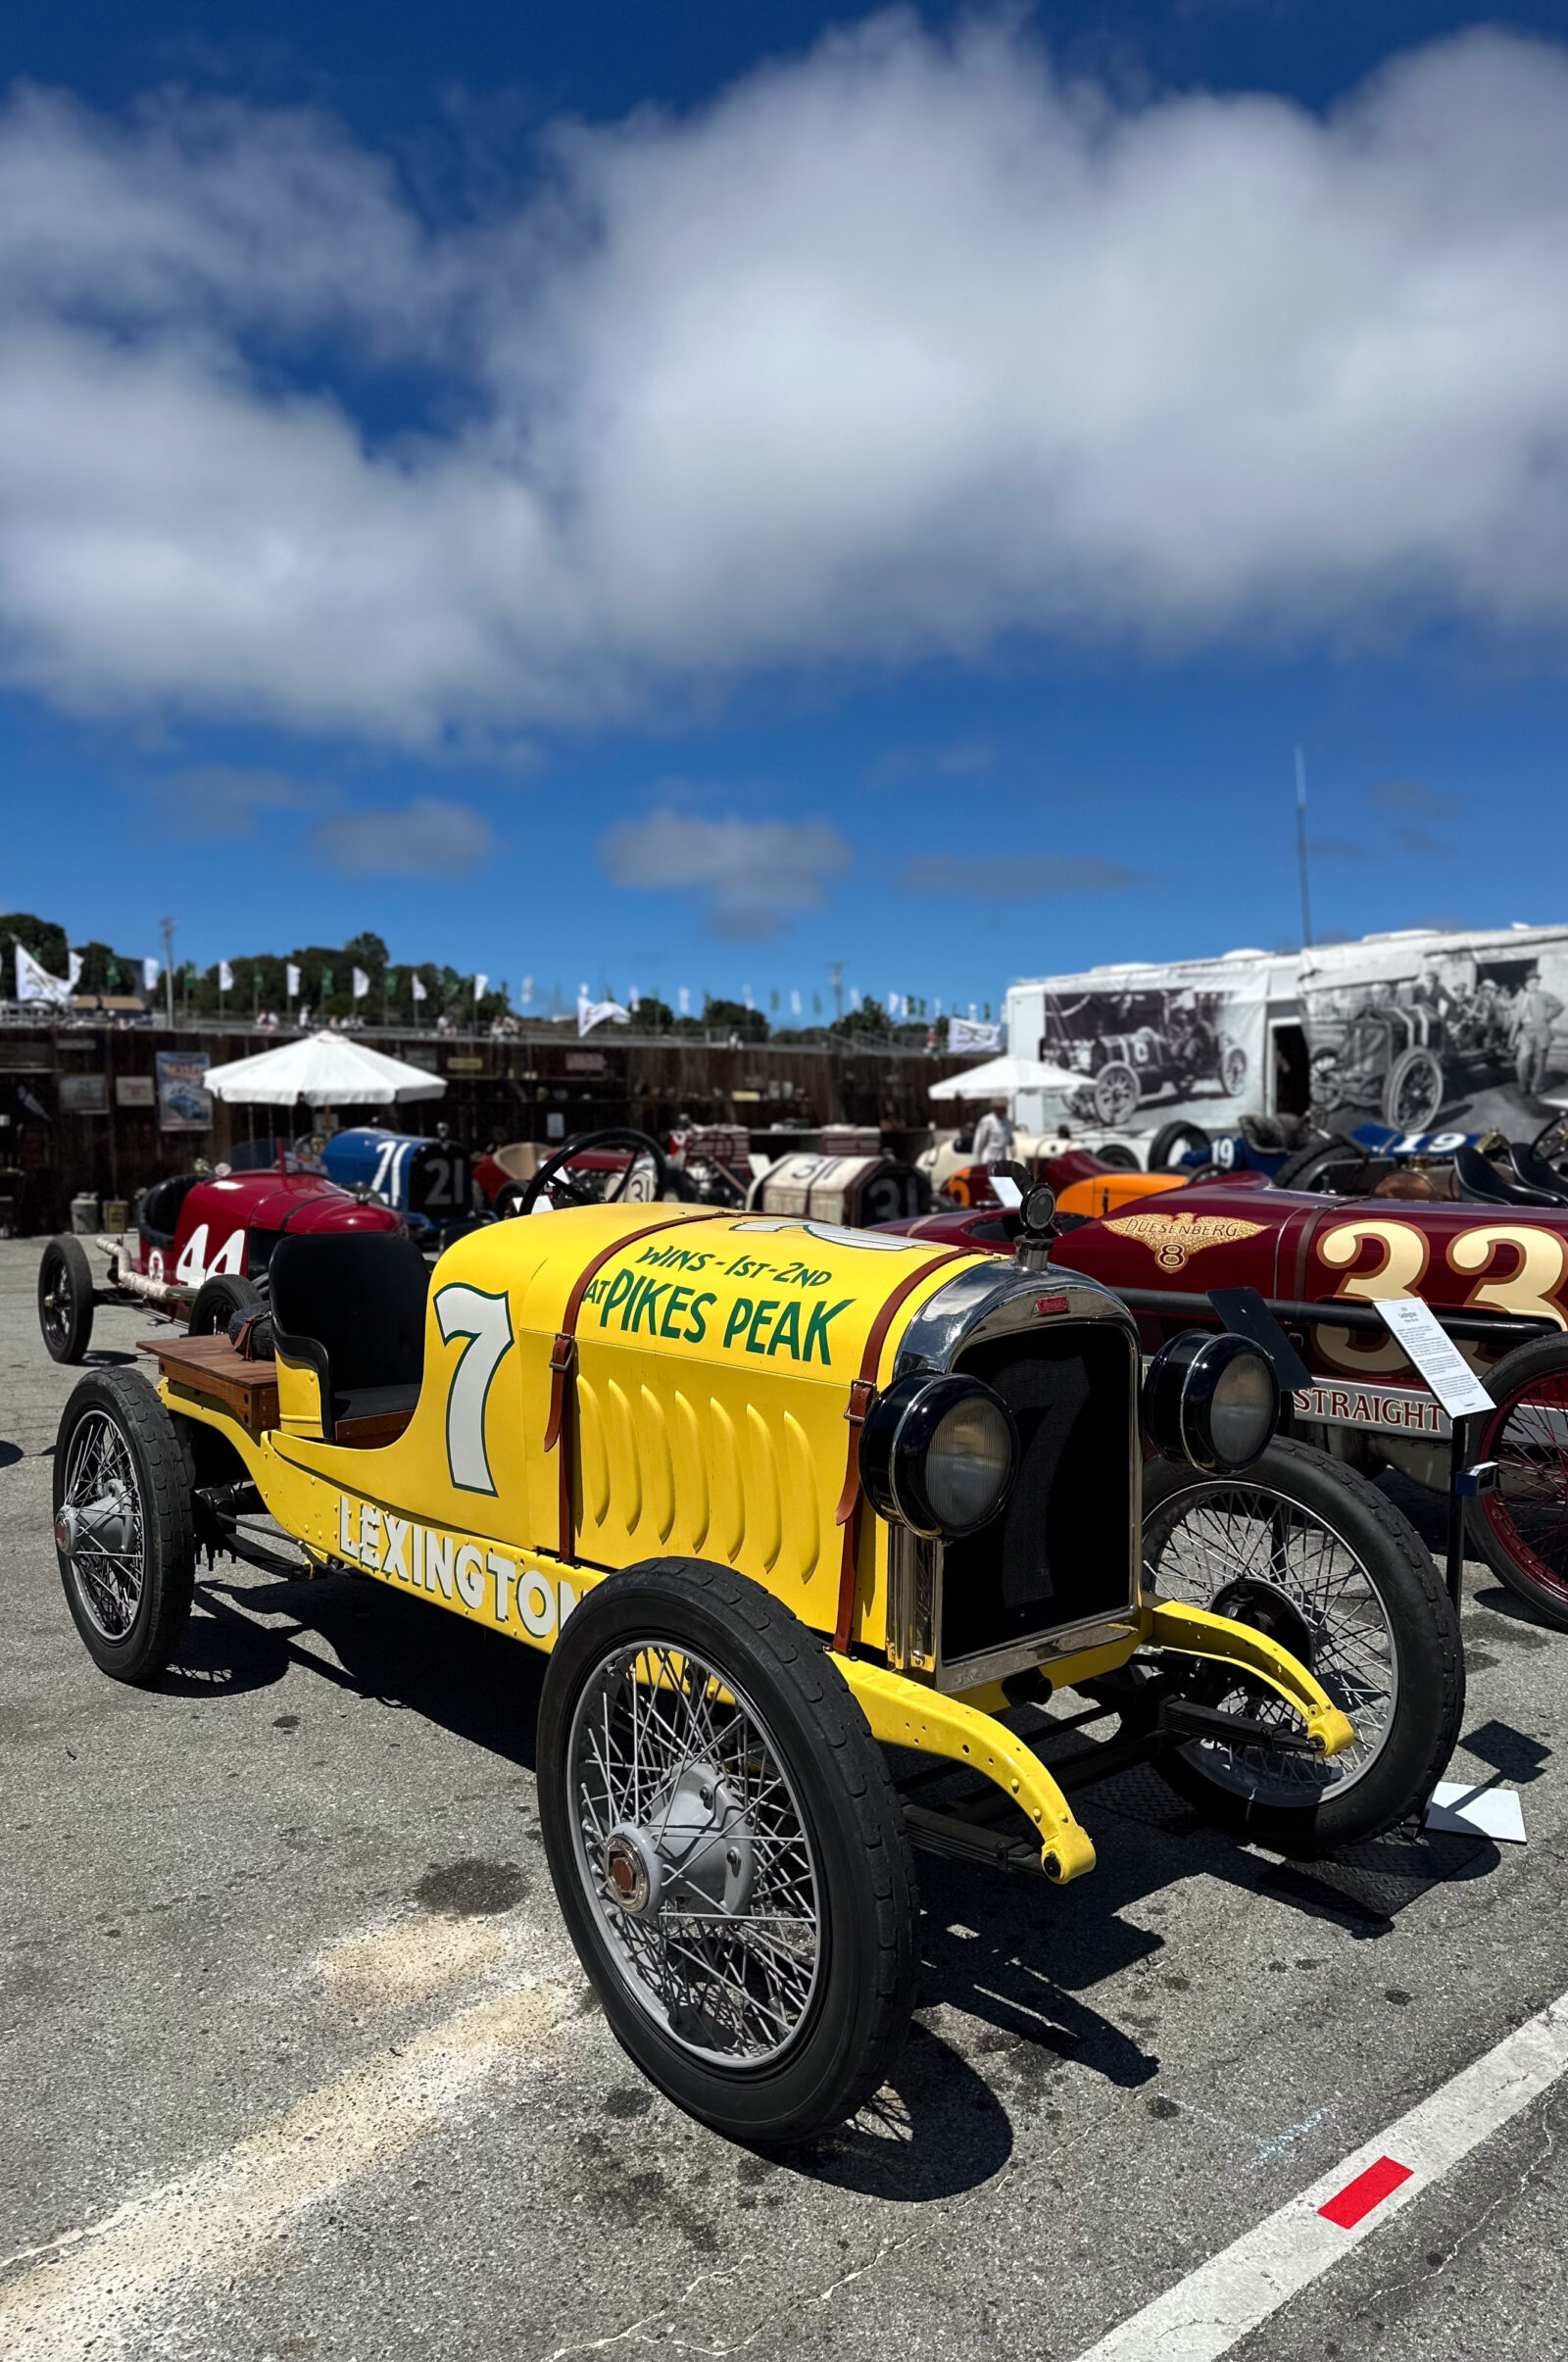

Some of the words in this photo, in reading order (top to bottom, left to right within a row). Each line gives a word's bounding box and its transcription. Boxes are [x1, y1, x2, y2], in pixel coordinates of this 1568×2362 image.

[1211, 1137, 1235, 1169] 19
[1394, 1132, 1468, 1153] 19
[424, 1158, 465, 1206] 21
[868, 1177, 919, 1225] 31
[1125, 1218, 1240, 1238] DUESENBERG
[175, 1223, 245, 1289] 44
[1157, 1243, 1186, 1268] 8
[581, 1279, 612, 1304] AT
[599, 1268, 717, 1344] PIKES
[722, 1298, 858, 1366] PEAK
[433, 1282, 515, 1498] 7
[1294, 1387, 1443, 1434] STRAIGHT
[993, 1355, 1092, 1612] 7
